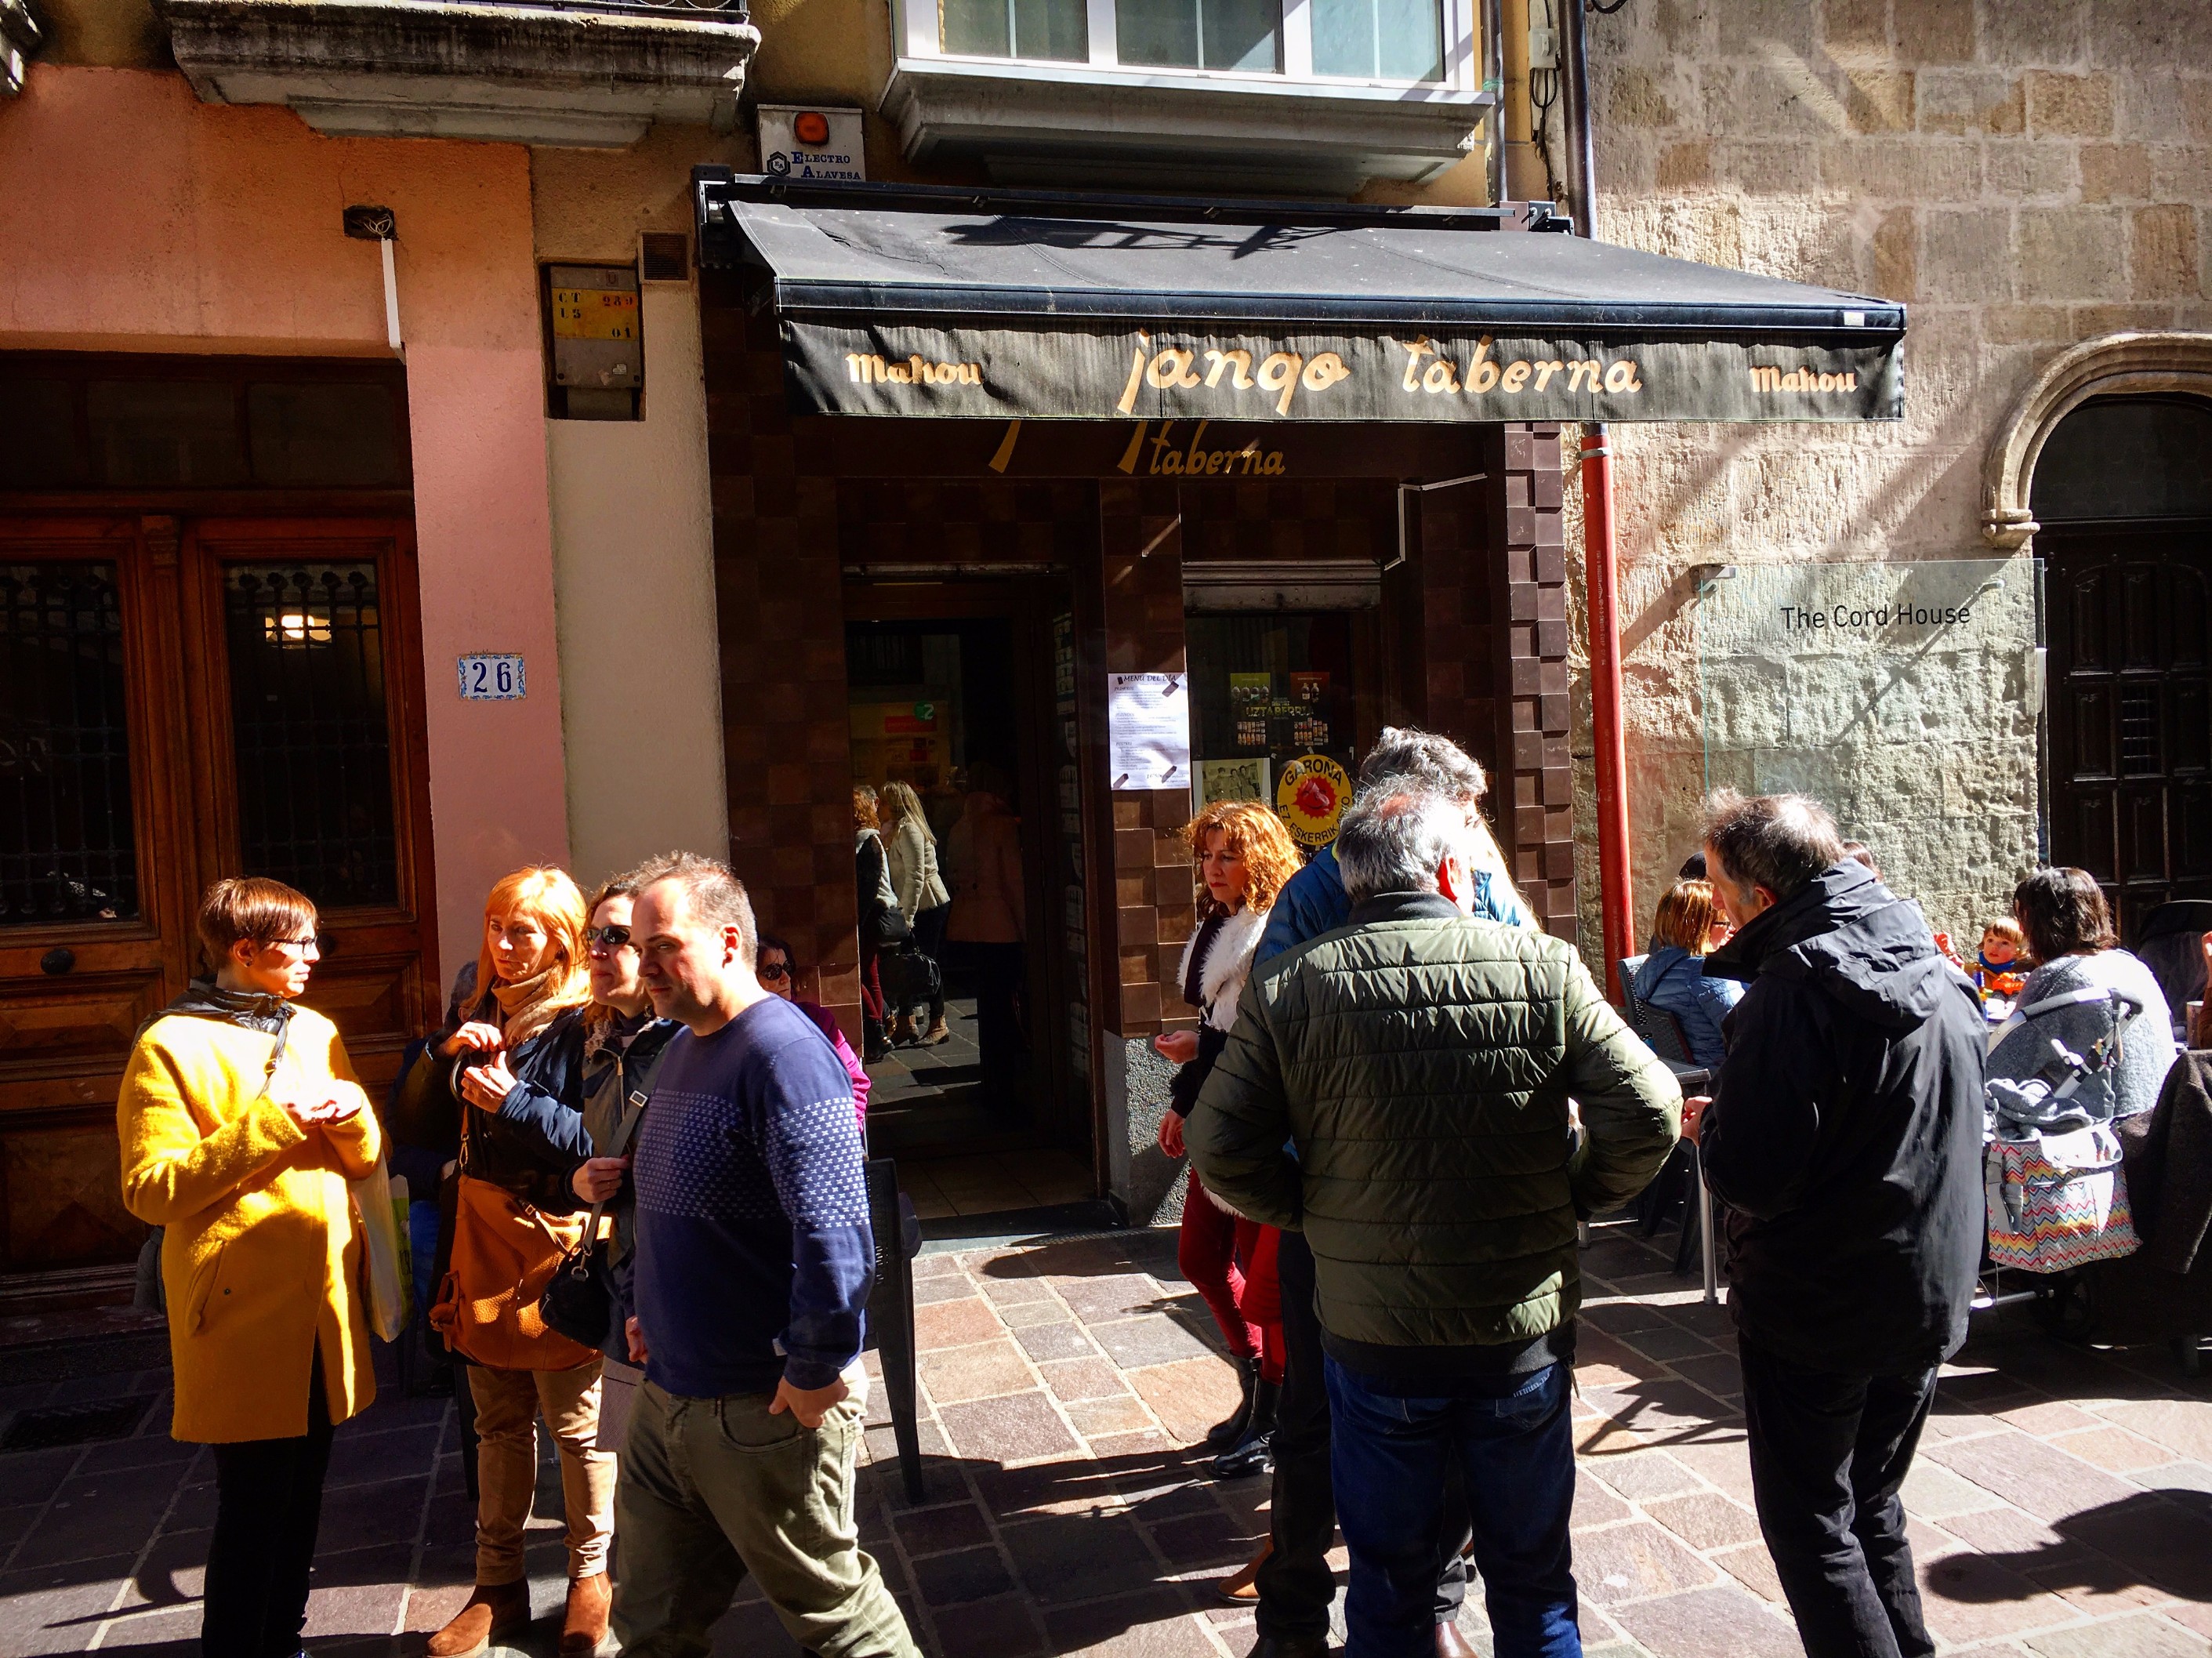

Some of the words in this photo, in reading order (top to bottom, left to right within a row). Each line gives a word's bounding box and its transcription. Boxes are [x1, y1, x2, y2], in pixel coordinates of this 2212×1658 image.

[791, 151, 850, 164] ELECTRO
[801, 165, 861, 180] ALAVESA
[603, 295, 633, 307] 289
[612, 327, 631, 338] 01
[845, 353, 984, 385] Mahou
[1402, 334, 1643, 394] taberna
[1750, 366, 1858, 392] Mahou
[1149, 421, 1285, 474] taberna
[1780, 607, 1825, 629] The
[1834, 604, 1887, 627] Cord
[1898, 603, 1971, 625] House
[473, 662, 512, 693] 26
[1279, 804, 1291, 820] EZ
[1289, 822, 1337, 843] ESKERRIK
